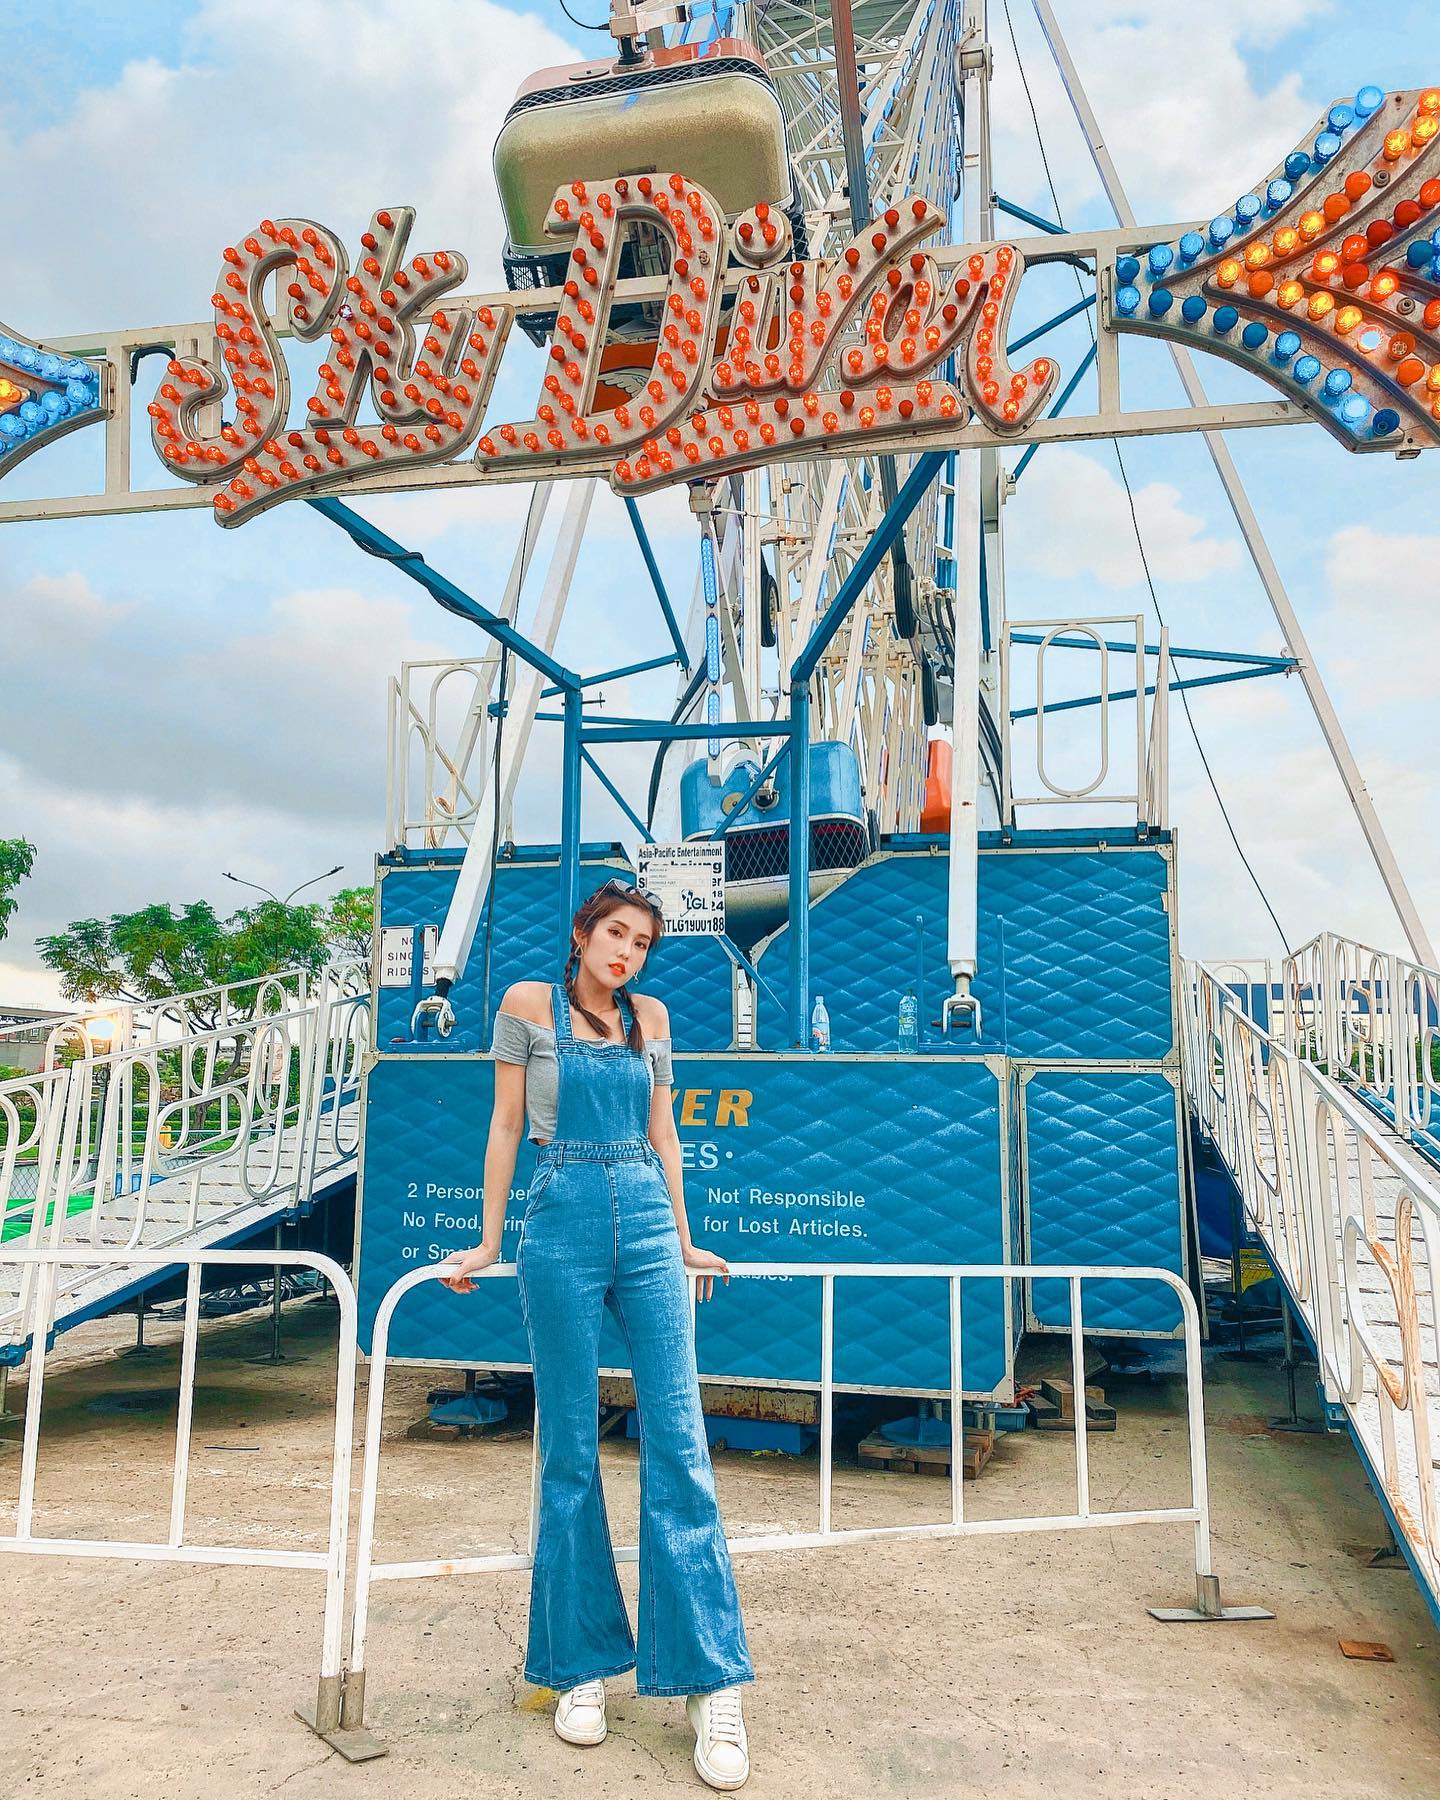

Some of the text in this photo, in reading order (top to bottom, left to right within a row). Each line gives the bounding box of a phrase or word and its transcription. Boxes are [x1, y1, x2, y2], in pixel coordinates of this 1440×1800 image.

[150, 172, 1060, 530] Sky Diver
[638, 846, 722, 859] Asia-Pacific Entertainment
[387, 950, 430, 961] SINGE
[387, 967, 429, 976] RIDES
[407, 1183, 418, 1198] 2
[426, 1183, 484, 1200] Person
[708, 1188, 866, 1208] Not Responsible
[403, 1212, 426, 1228] No
[434, 1213, 482, 1232] Food,
[703, 1216, 868, 1238] for Lost Articles.
[402, 1246, 419, 1259] or
